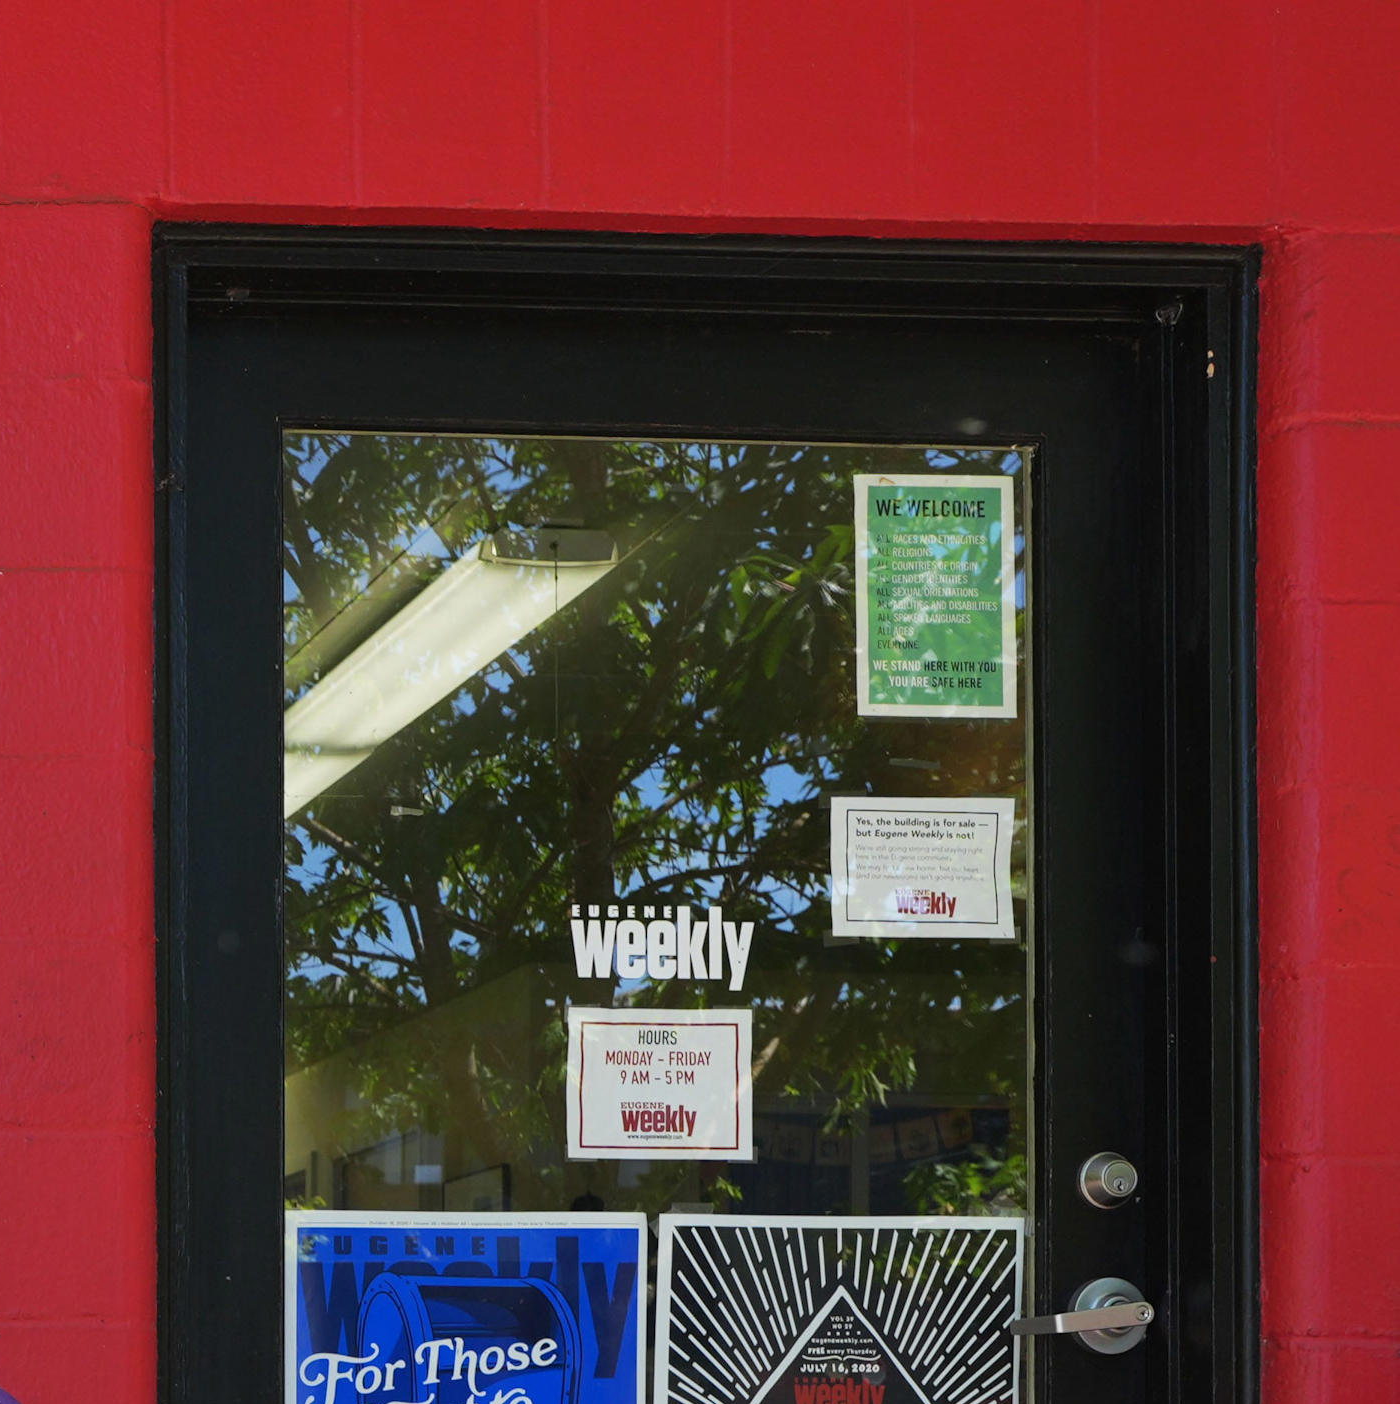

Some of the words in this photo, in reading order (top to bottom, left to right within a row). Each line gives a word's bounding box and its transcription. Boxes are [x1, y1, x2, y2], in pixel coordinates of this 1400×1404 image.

[875, 499, 902, 517] WE
[907, 500, 986, 518] WELCOME
[892, 534, 918, 544] RACES
[892, 547, 933, 558] RELIGIONS
[891, 560, 938, 571] COUNTRIES
[950, 561, 978, 572] ORIGIN
[891, 574, 924, 584] GENDER
[876, 588, 890, 597] ALL
[891, 588, 922, 597] SEXUAL
[924, 588, 979, 598] ORIENTATIONS
[931, 601, 947, 610] AND
[949, 601, 998, 612] DISABILITIES
[925, 614, 972, 624] LANGUAGES
[873, 659, 888, 671] WE
[891, 660, 921, 671] STAND
[924, 661, 948, 672] HERE
[951, 661, 975, 672] WITH
[978, 661, 997, 673] YOU
[888, 675, 908, 687] YOU
[912, 676, 929, 688] ARE
[931, 677, 955, 688] SAFE
[957, 677, 982, 688] HERE
[855, 817, 873, 827] Yes,
[876, 818, 893, 826] the
[894, 818, 930, 829] building
[933, 818, 940, 827] is
[943, 819, 956, 827] for
[958, 819, 976, 828] sale
[856, 829, 871, 837] but
[874, 829, 908, 840] Eugene
[911, 830, 944, 840] Weekly
[946, 831, 954, 839] is
[956, 831, 975, 840] not!
[896, 891, 957, 918] weekly
[571, 904, 672, 919] EUGENE
[570, 905, 755, 991] weekly
[638, 1029, 678, 1045] HOURS
[605, 1050, 653, 1066] MONDAY
[669, 1051, 711, 1067] FRIDAY
[620, 1070, 627, 1085] 9
[631, 1070, 650, 1085] AM
[665, 1070, 672, 1085] 5
[676, 1070, 695, 1085] PM
[620, 1101, 665, 1110] EUGENE
[621, 1104, 697, 1137] weekly
[305, 1236, 486, 1256] UGENE
[811, 1337, 873, 1345] eugeneweekly.com
[807, 1347, 826, 1355] FREE
[846, 1347, 877, 1356] Thursday
[414, 1336, 559, 1397] Those
[800, 1363, 828, 1373] JULY
[831, 1363, 849, 1375] 16,
[851, 1363, 880, 1374] 2020
